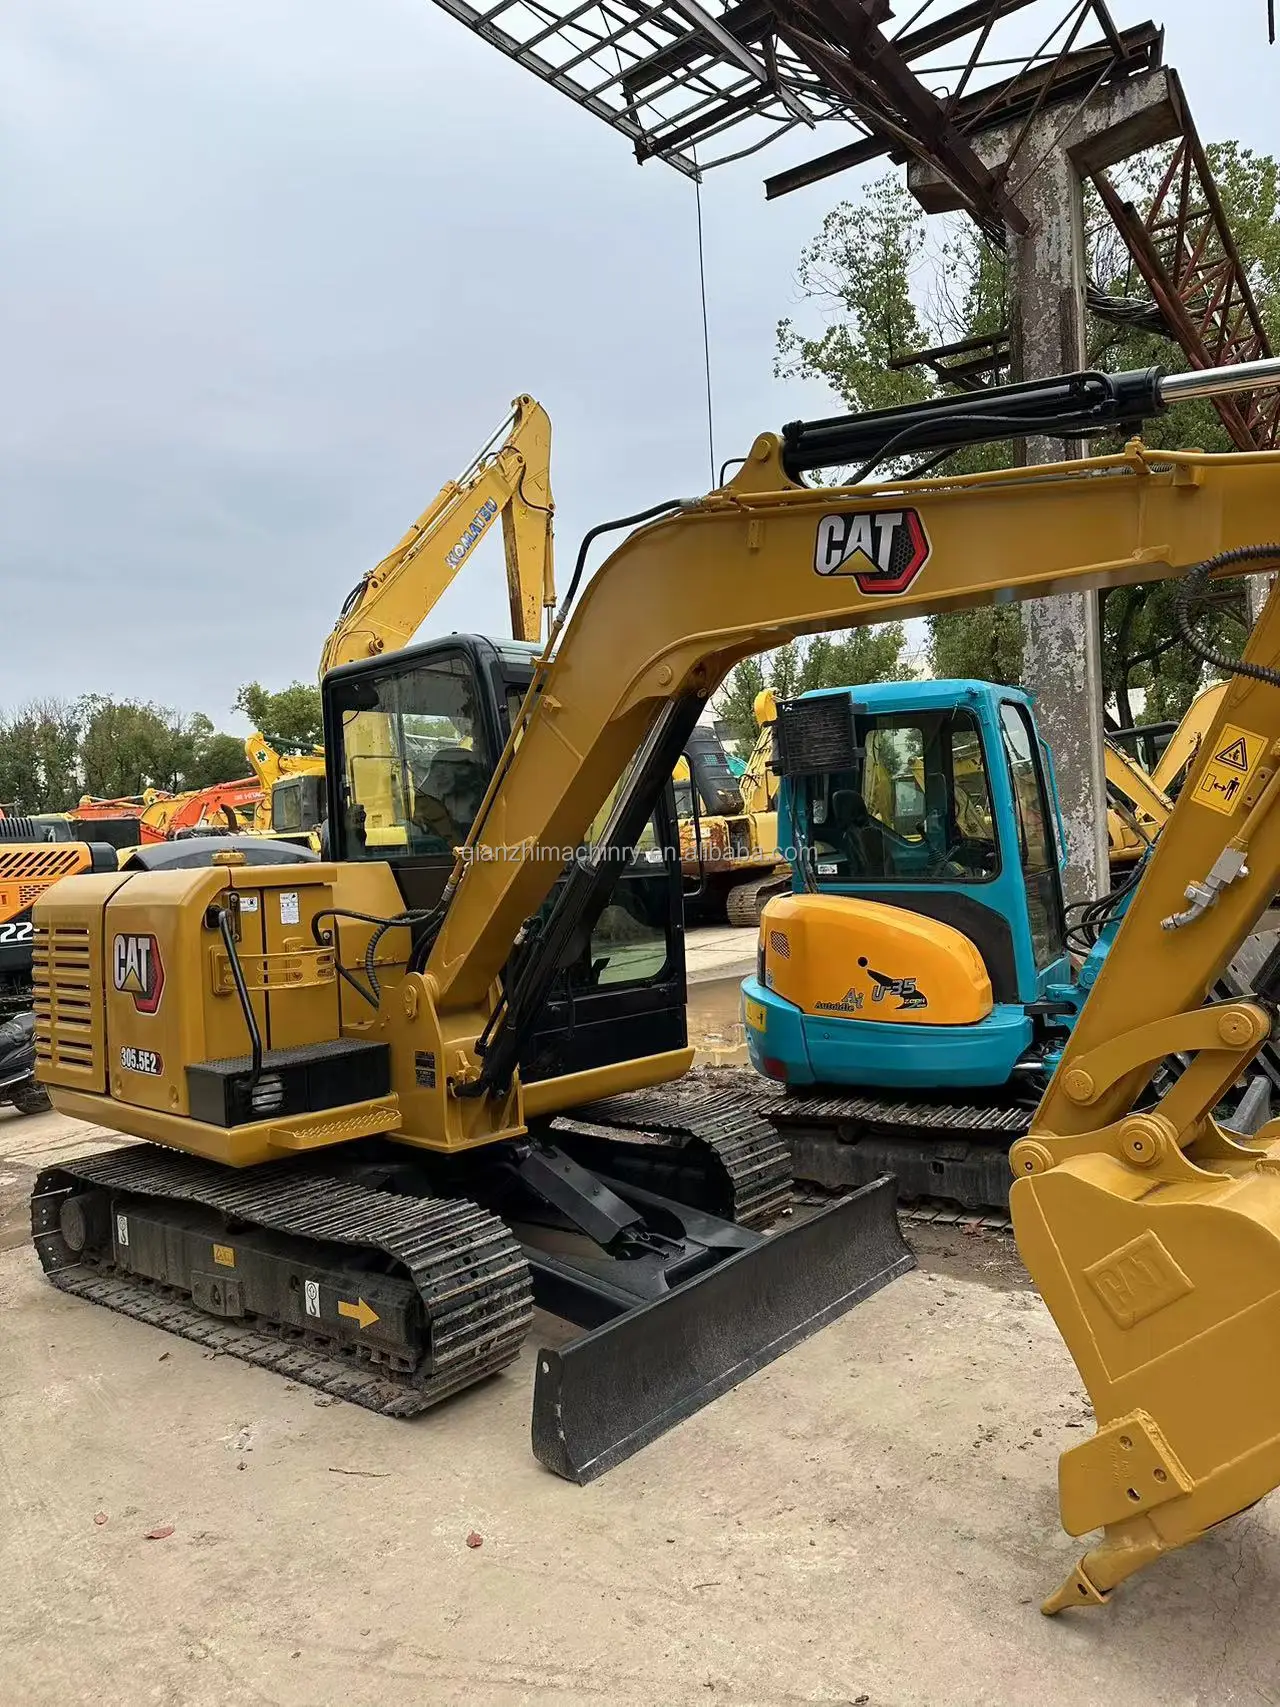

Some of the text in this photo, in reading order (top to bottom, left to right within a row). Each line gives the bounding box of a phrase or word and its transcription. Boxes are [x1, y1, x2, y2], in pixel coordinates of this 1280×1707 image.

[445, 496, 498, 568] KOMATSU
[816, 512, 903, 575] CAT
[114, 934, 150, 992] CAT
[871, 978, 917, 1003] U-35
[120, 1046, 158, 1074] 305.5E2
